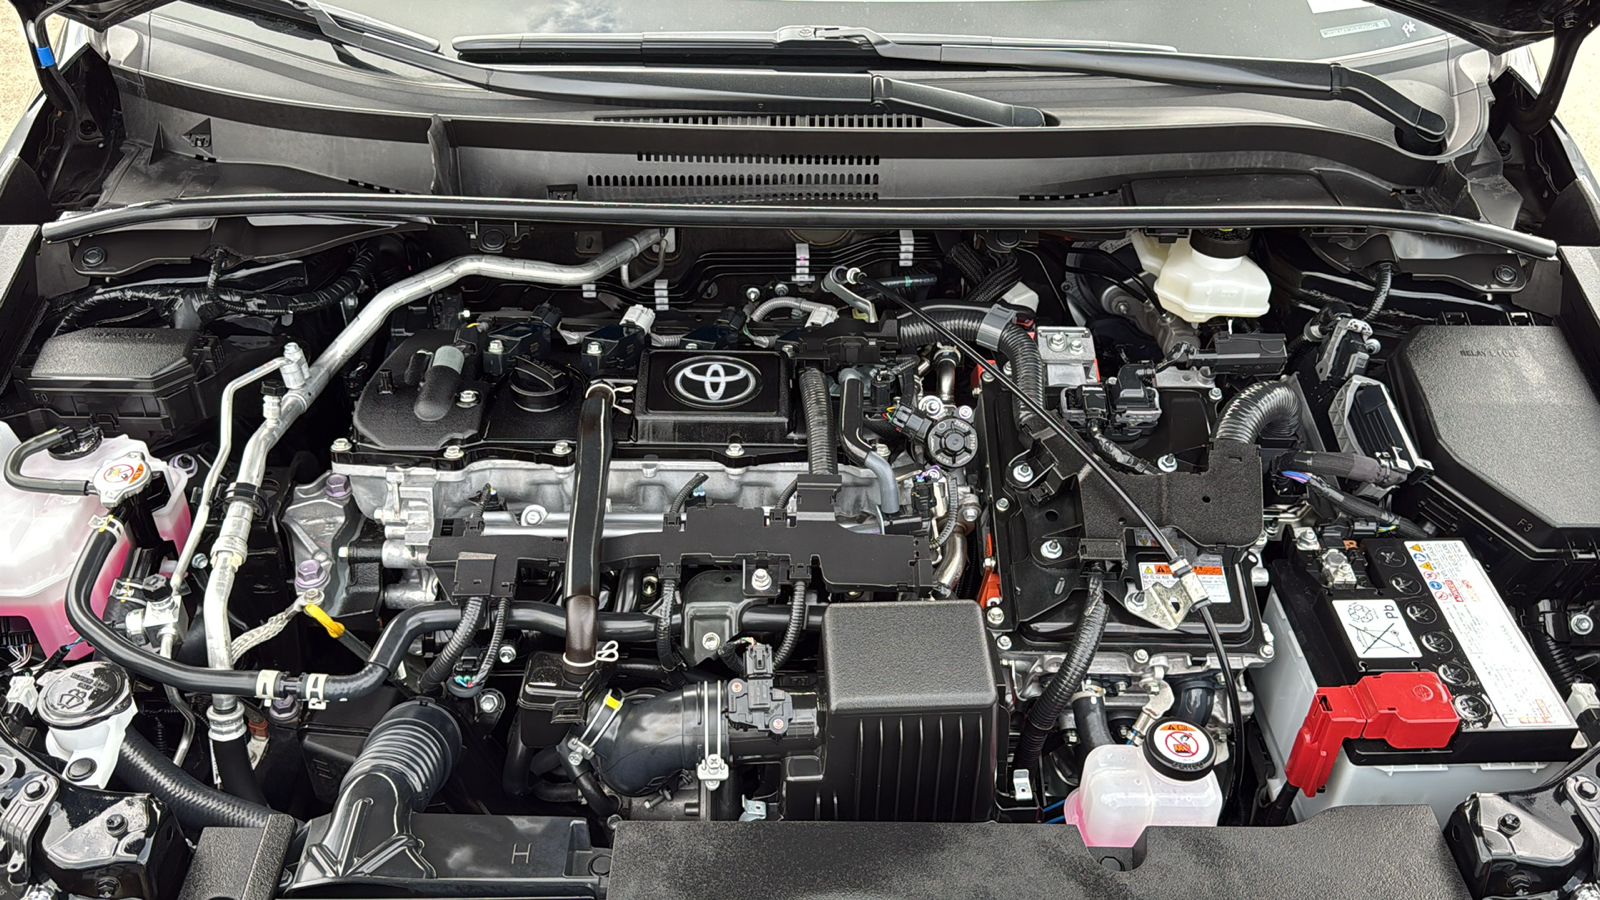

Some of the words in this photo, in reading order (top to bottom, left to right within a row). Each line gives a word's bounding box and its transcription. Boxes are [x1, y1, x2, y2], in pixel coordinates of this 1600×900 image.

[1516, 518, 1533, 532] F3
[1383, 604, 1399, 619] Pb
[511, 843, 532, 864] H
